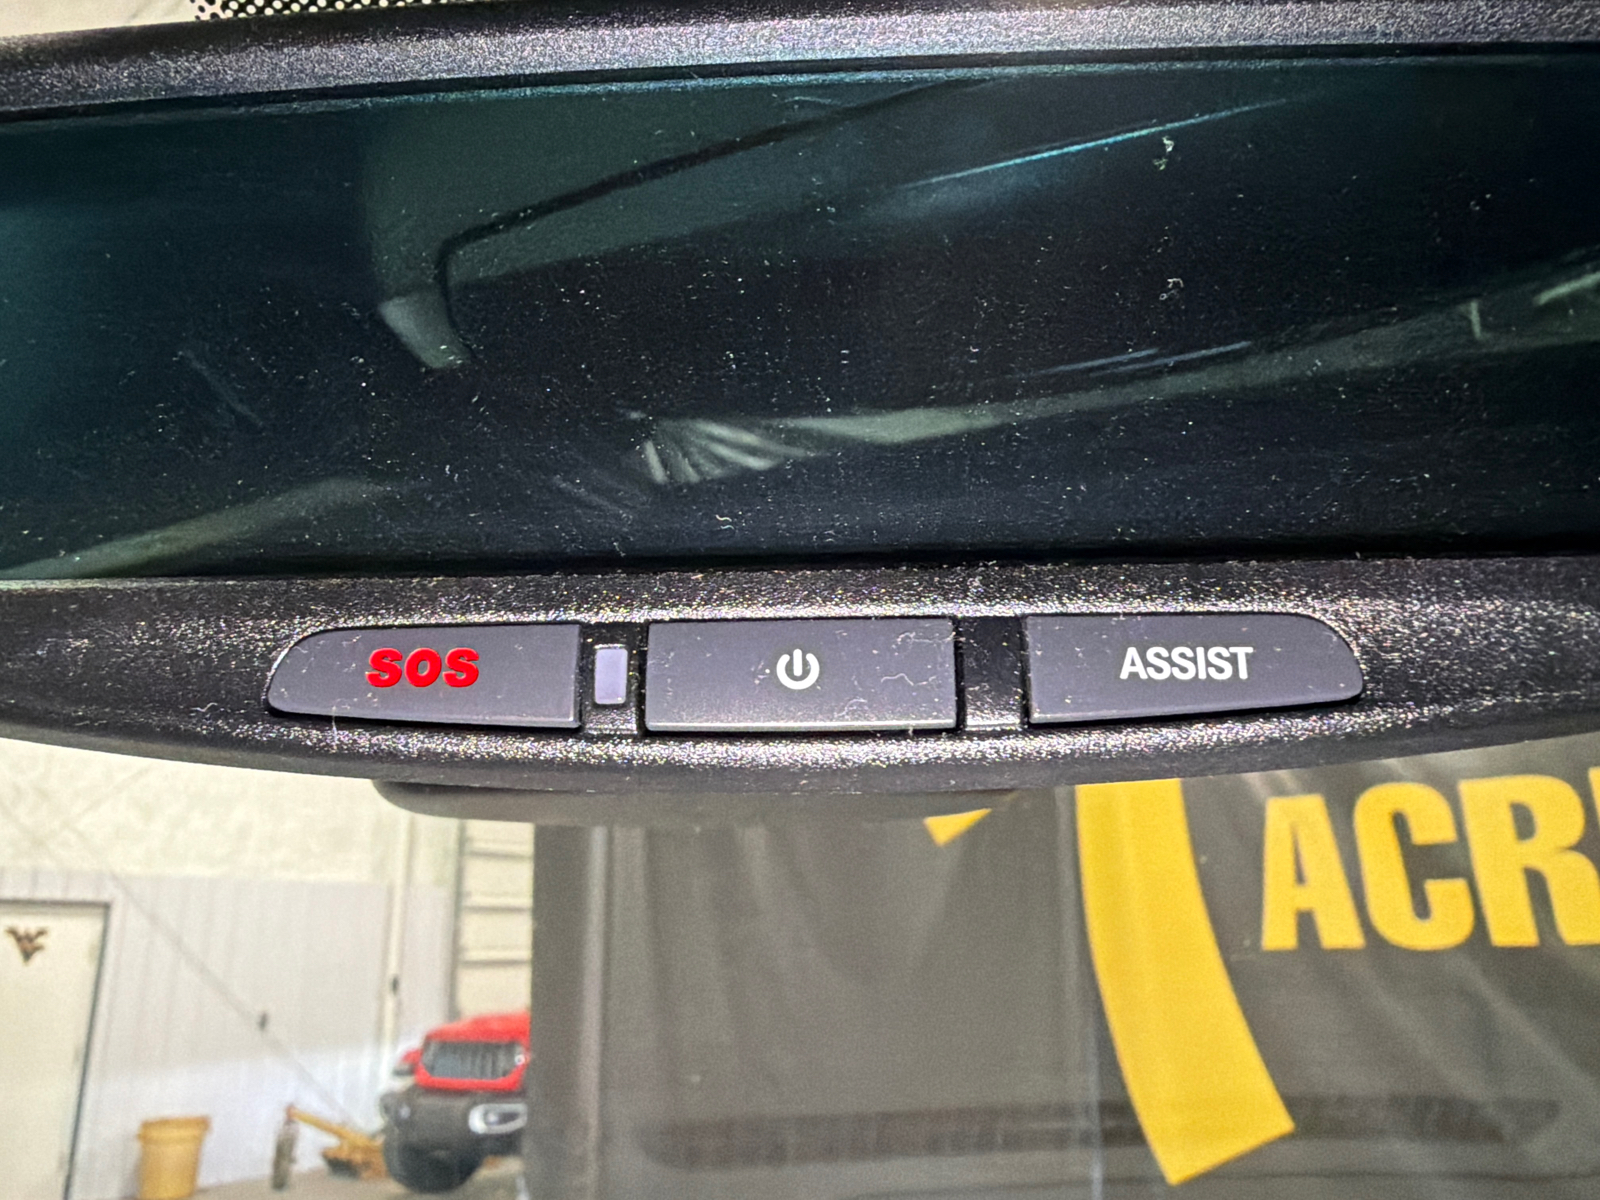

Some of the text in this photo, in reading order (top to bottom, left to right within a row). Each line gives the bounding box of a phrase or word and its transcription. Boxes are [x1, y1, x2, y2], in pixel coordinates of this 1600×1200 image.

[365, 647, 480, 688] SOS
[1119, 646, 1254, 681] ASSIST
[1262, 767, 1600, 950] ACR
